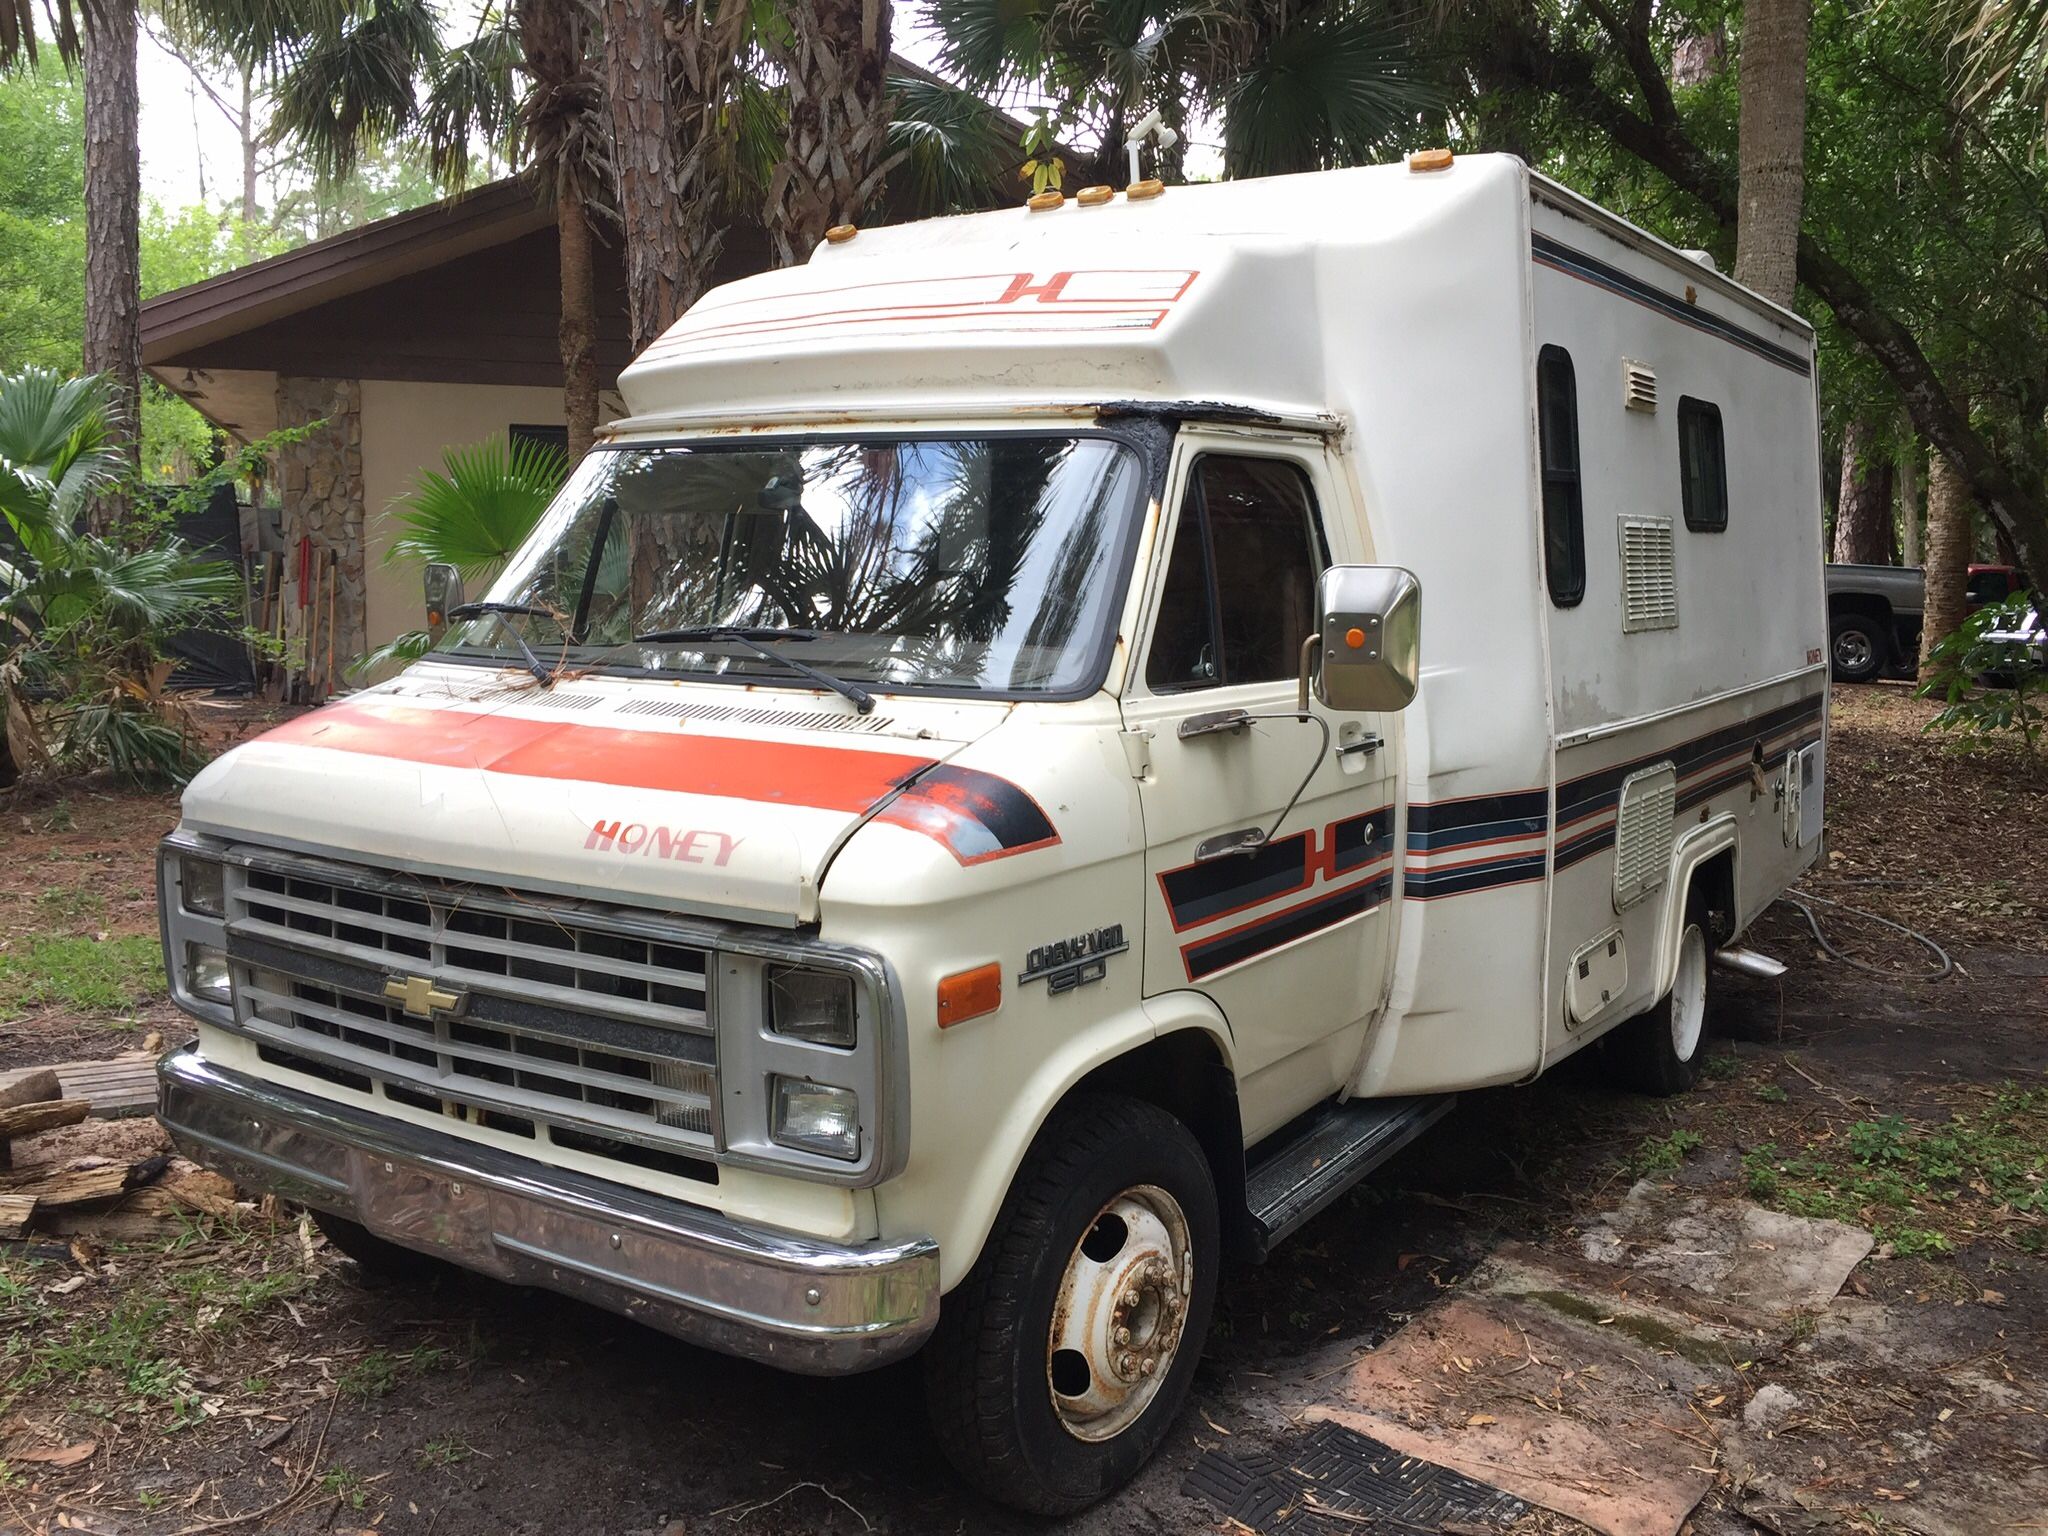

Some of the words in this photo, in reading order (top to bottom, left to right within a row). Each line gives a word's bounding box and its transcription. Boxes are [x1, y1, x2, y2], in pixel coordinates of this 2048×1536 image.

[998, 271, 1073, 303] H
[584, 820, 746, 867] HONEY
[1304, 823, 1337, 888] H
[1027, 935, 1085, 972] CHEVY
[1087, 923, 1123, 955] VAN
